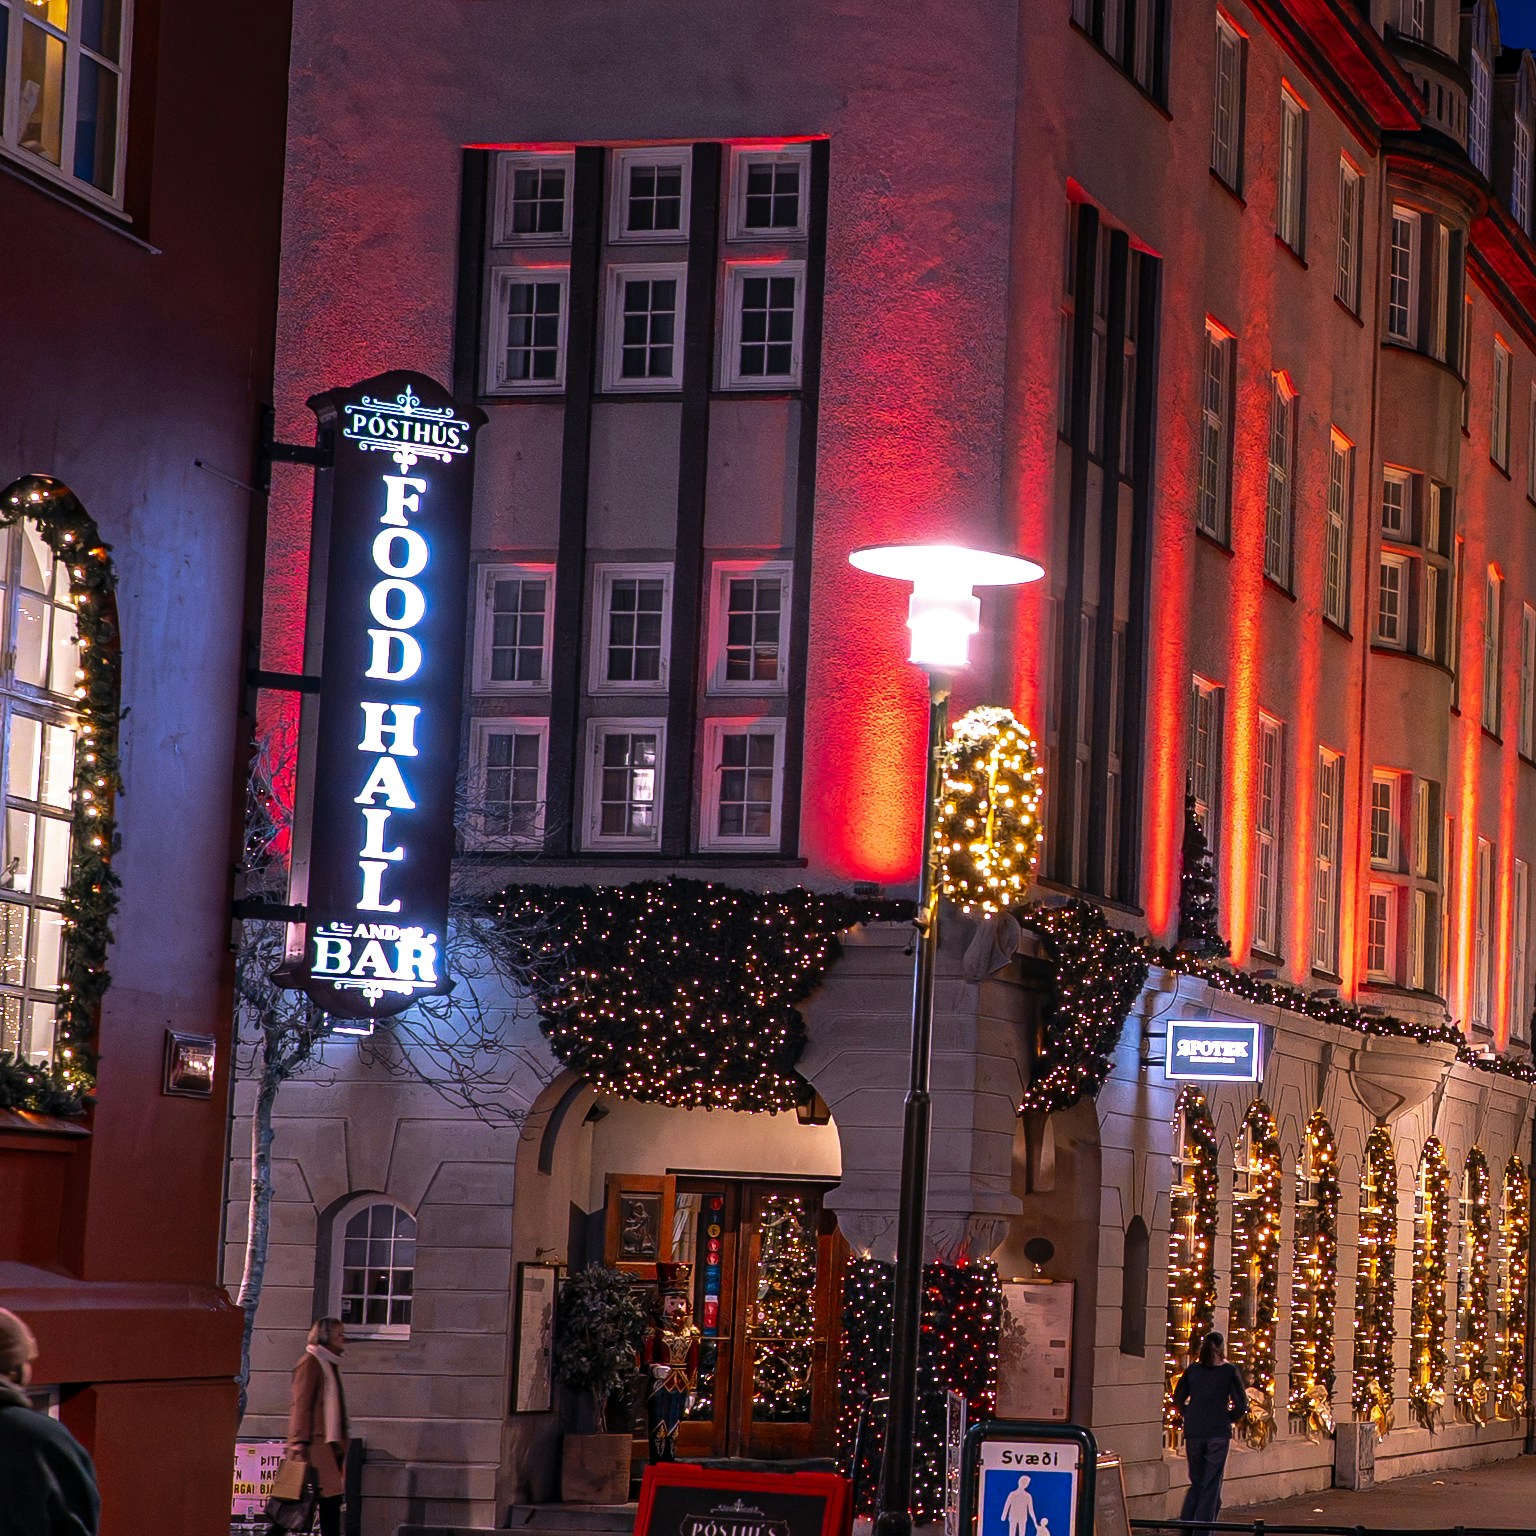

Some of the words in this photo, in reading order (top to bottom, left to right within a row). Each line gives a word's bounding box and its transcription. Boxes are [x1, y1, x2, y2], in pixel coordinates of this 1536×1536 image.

[353, 412, 460, 447] PÓSTHÚS
[364, 473, 430, 681] FOOD
[354, 701, 422, 914] HALL
[353, 923, 401, 941] AND
[311, 936, 438, 982] BAR
[1001, 1450, 1058, 1466] Svæði
